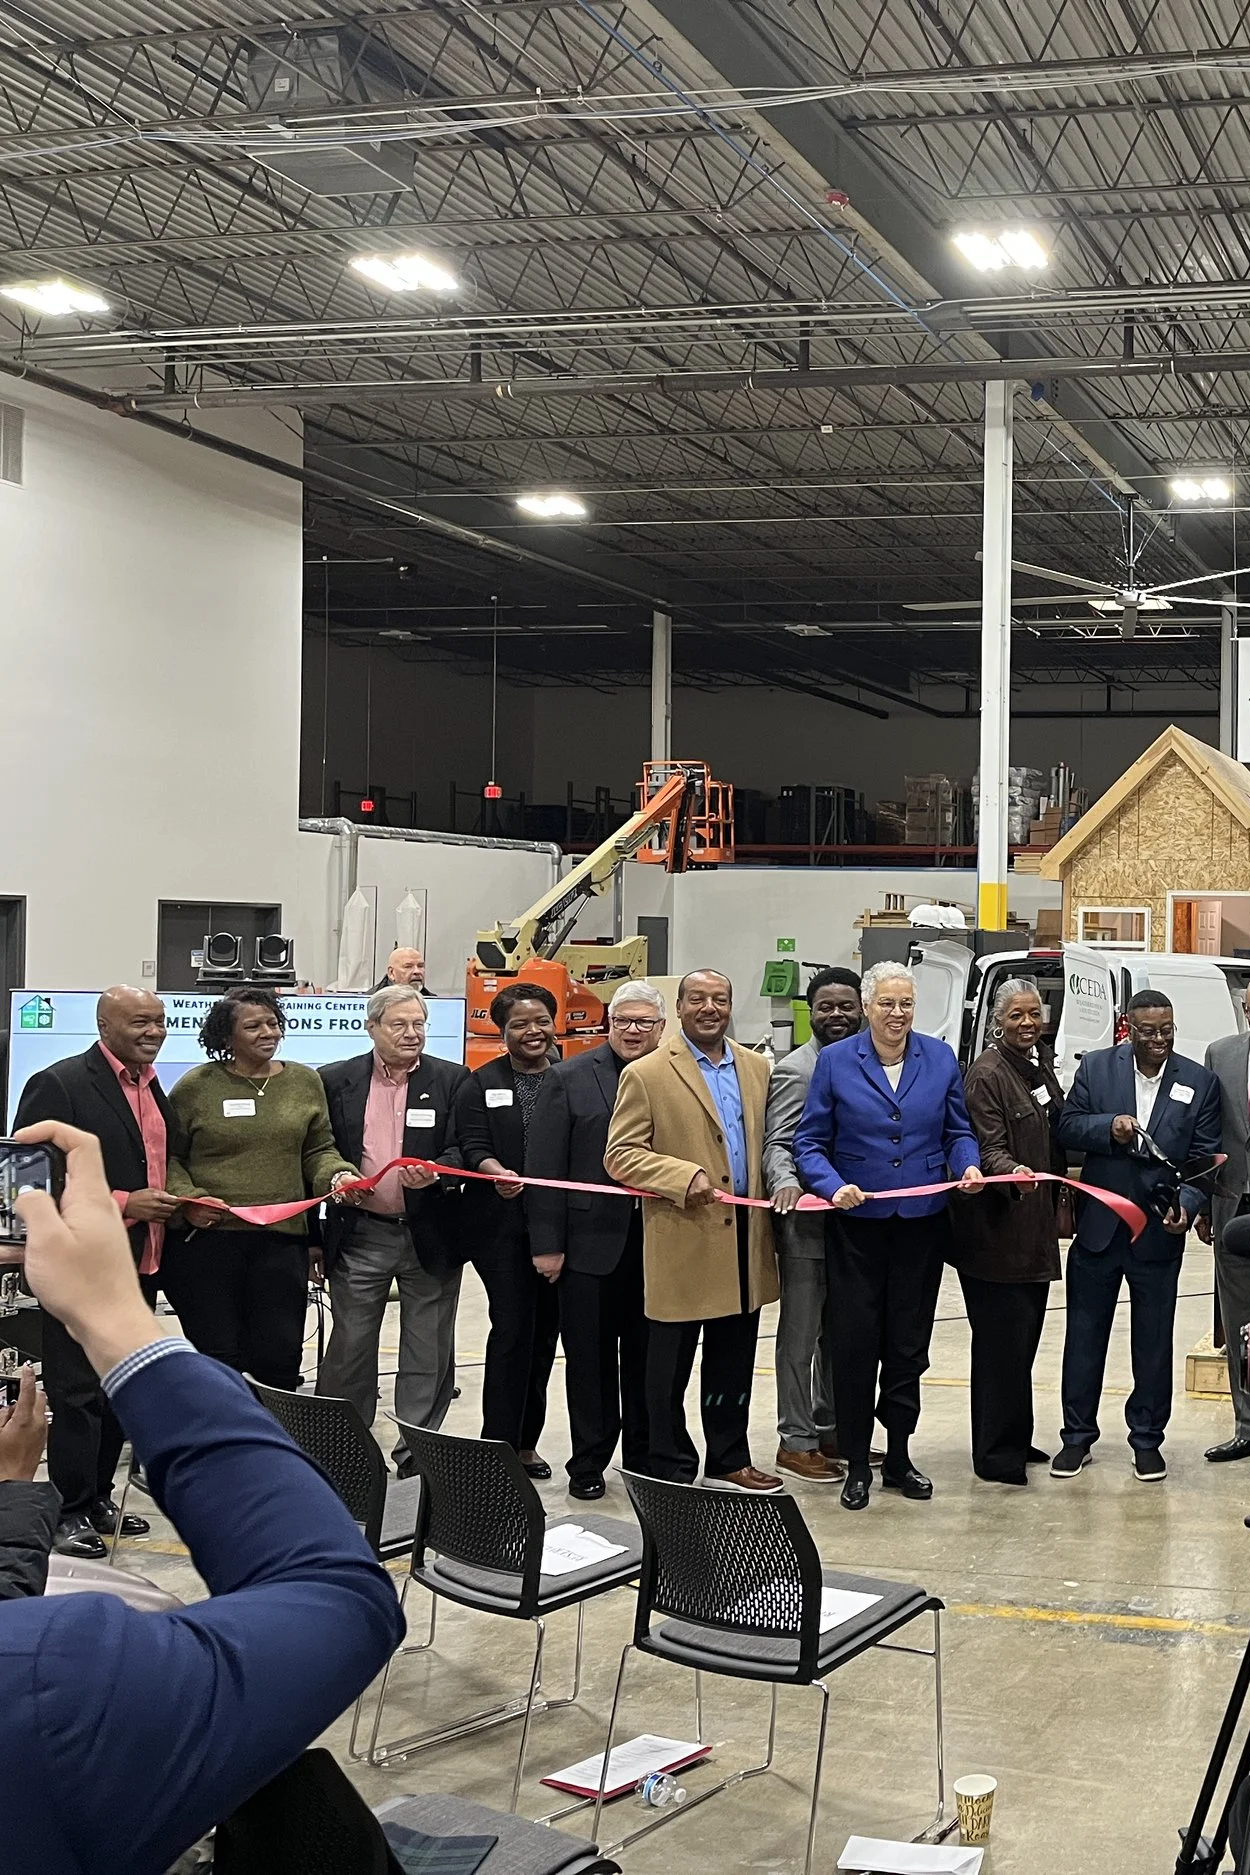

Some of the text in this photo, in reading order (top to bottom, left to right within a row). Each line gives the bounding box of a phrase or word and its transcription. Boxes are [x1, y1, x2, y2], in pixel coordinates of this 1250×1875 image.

[1079, 977, 1107, 1000] CEDA
[277, 1001, 321, 1010] RAINING
[325, 1001, 365, 1010] CENTER
[471, 1008, 487, 1019] JLG
[287, 1018, 323, 1030] ONS
[329, 1018, 368, 1030] FRO
